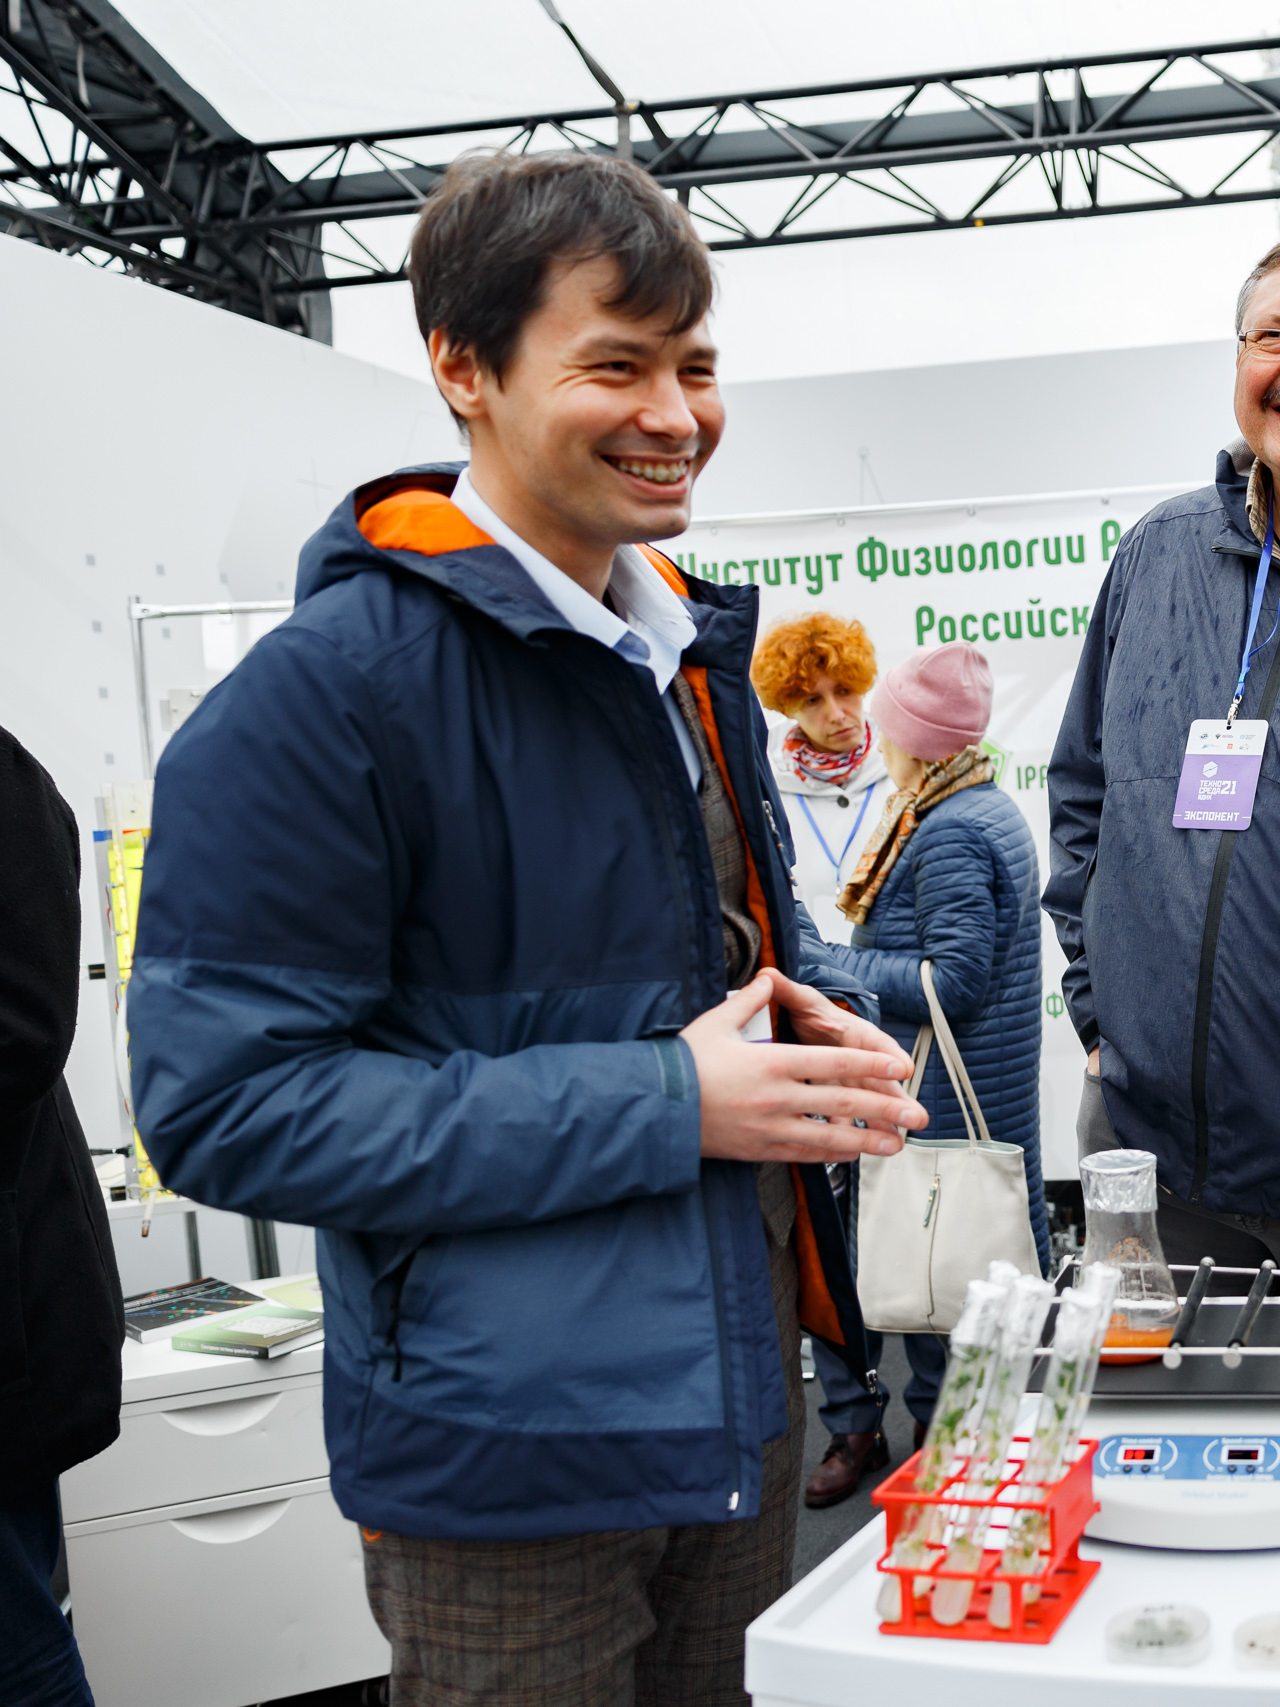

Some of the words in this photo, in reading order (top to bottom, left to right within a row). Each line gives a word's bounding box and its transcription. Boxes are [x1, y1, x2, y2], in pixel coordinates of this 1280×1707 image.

[857, 534, 1084, 582] Физиологии
[1221, 781, 1236, 795] 21
[1184, 811, 1240, 821] ЭКСПОНЕНТ
